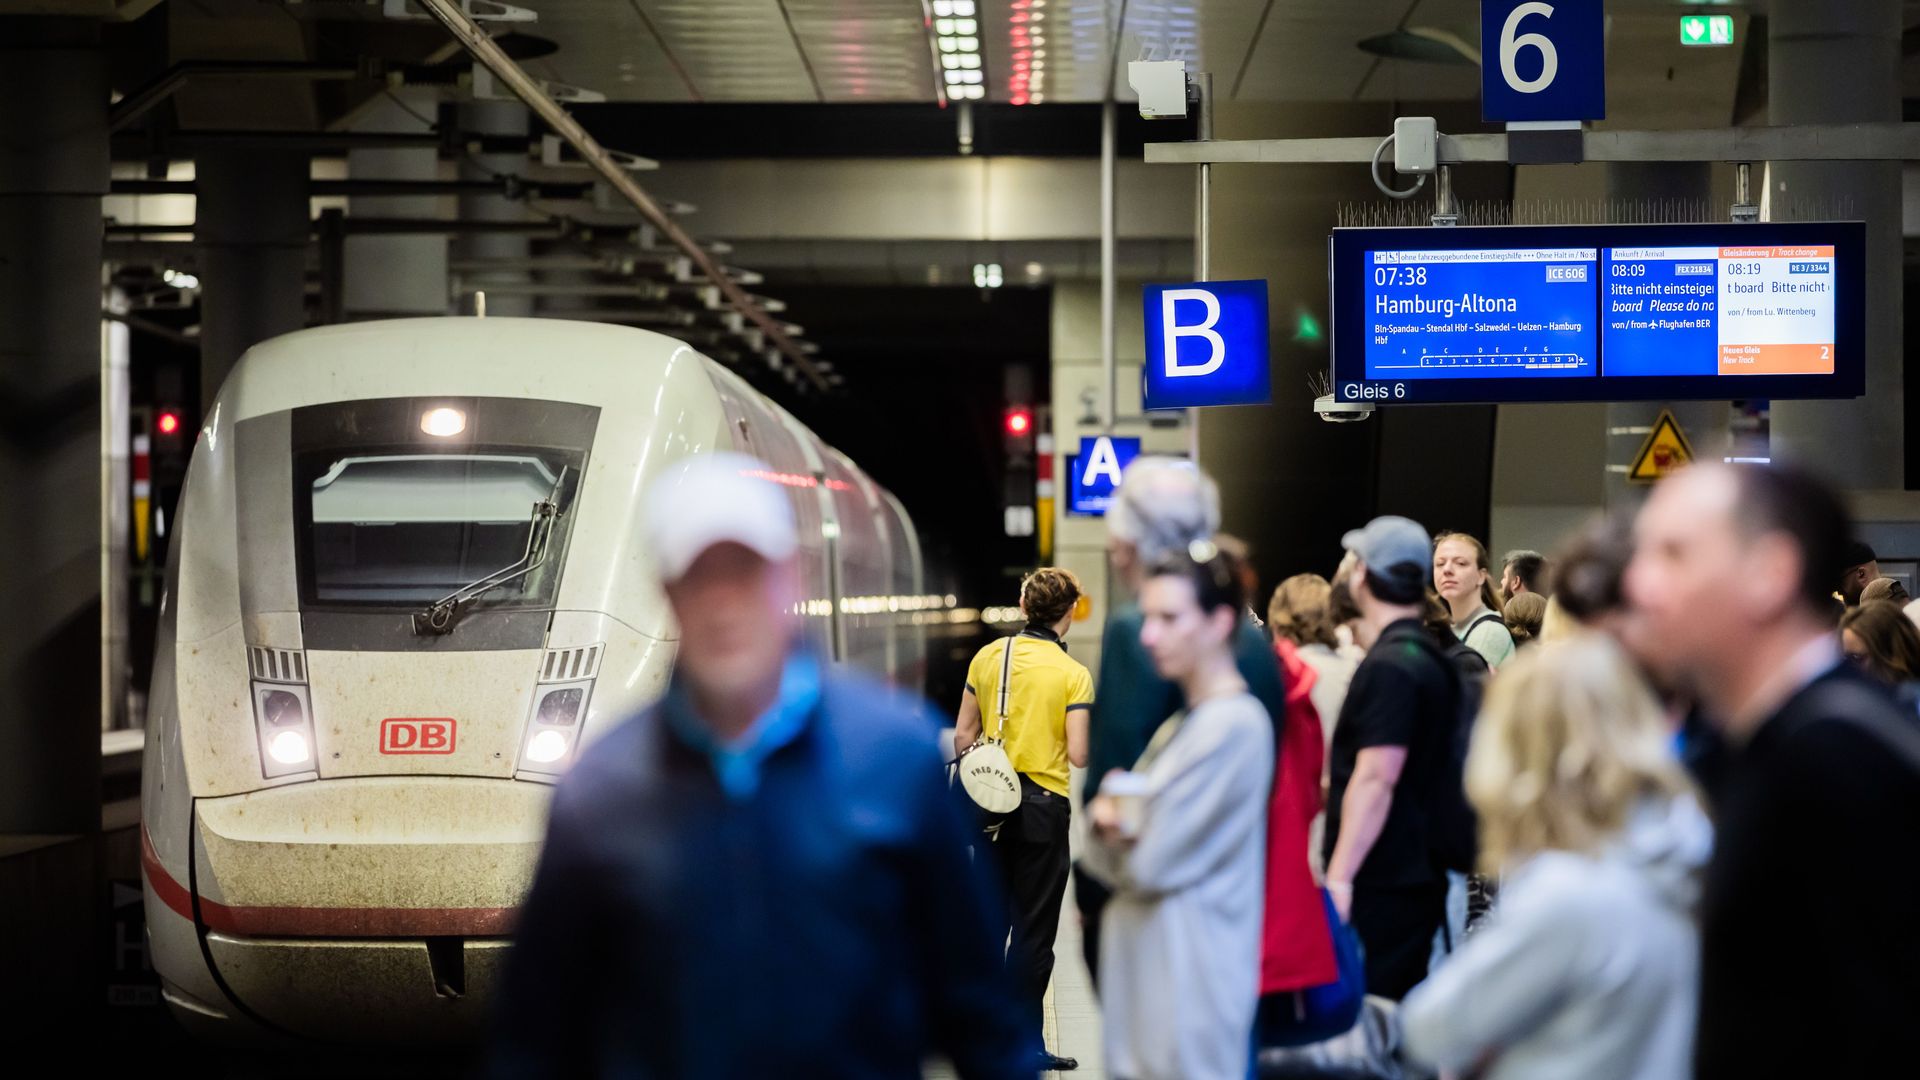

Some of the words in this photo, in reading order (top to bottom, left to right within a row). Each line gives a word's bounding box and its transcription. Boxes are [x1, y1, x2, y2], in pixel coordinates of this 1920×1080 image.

[1500, 1, 1558, 94] 6
[1418, 252, 1479, 261] fahrzeuggebundene
[1480, 252, 1522, 261] Einstiegshilfe
[1537, 251, 1553, 259] Ohne
[1723, 248, 1769, 258] Gleisänderung
[1795, 248, 1818, 257] change
[1549, 269, 1564, 279] ICE
[1565, 268, 1585, 279] 606
[1612, 264, 1645, 277] 08:09
[1728, 263, 1760, 275] 08:19
[1374, 267, 1427, 286] 07:38
[1636, 283, 1661, 294] nicht
[1735, 282, 1764, 293] board
[1772, 282, 1796, 293] Bitte
[1800, 281, 1825, 293] nicht
[1376, 293, 1516, 318] Hamburg-Altona
[1612, 300, 1643, 312] board
[1650, 299, 1684, 312] Please
[1686, 299, 1699, 311] do
[1747, 308, 1763, 316] from
[1777, 307, 1816, 317] Wittenberg
[1375, 324, 1419, 335] Bln-Spandau
[1426, 324, 1453, 332] Stendal
[1455, 323, 1468, 332] Hbf
[1475, 323, 1510, 332] Salzwedel
[1517, 322, 1542, 331] Uelzen
[1549, 322, 1582, 332] Hamburg
[1631, 320, 1648, 328] from
[1659, 319, 1694, 330] Flughafen
[1696, 319, 1710, 328] BER
[1162, 288, 1226, 378] B
[1375, 336, 1388, 345] Hbf
[1744, 346, 1760, 354] Gleis
[1821, 346, 1829, 359] 2
[1344, 383, 1389, 399] Gleis
[1394, 383, 1405, 398] 6
[1082, 436, 1122, 486] A
[388, 722, 449, 750] DB
[971, 766, 992, 777] FRED
[994, 769, 1016, 792] PERRY
